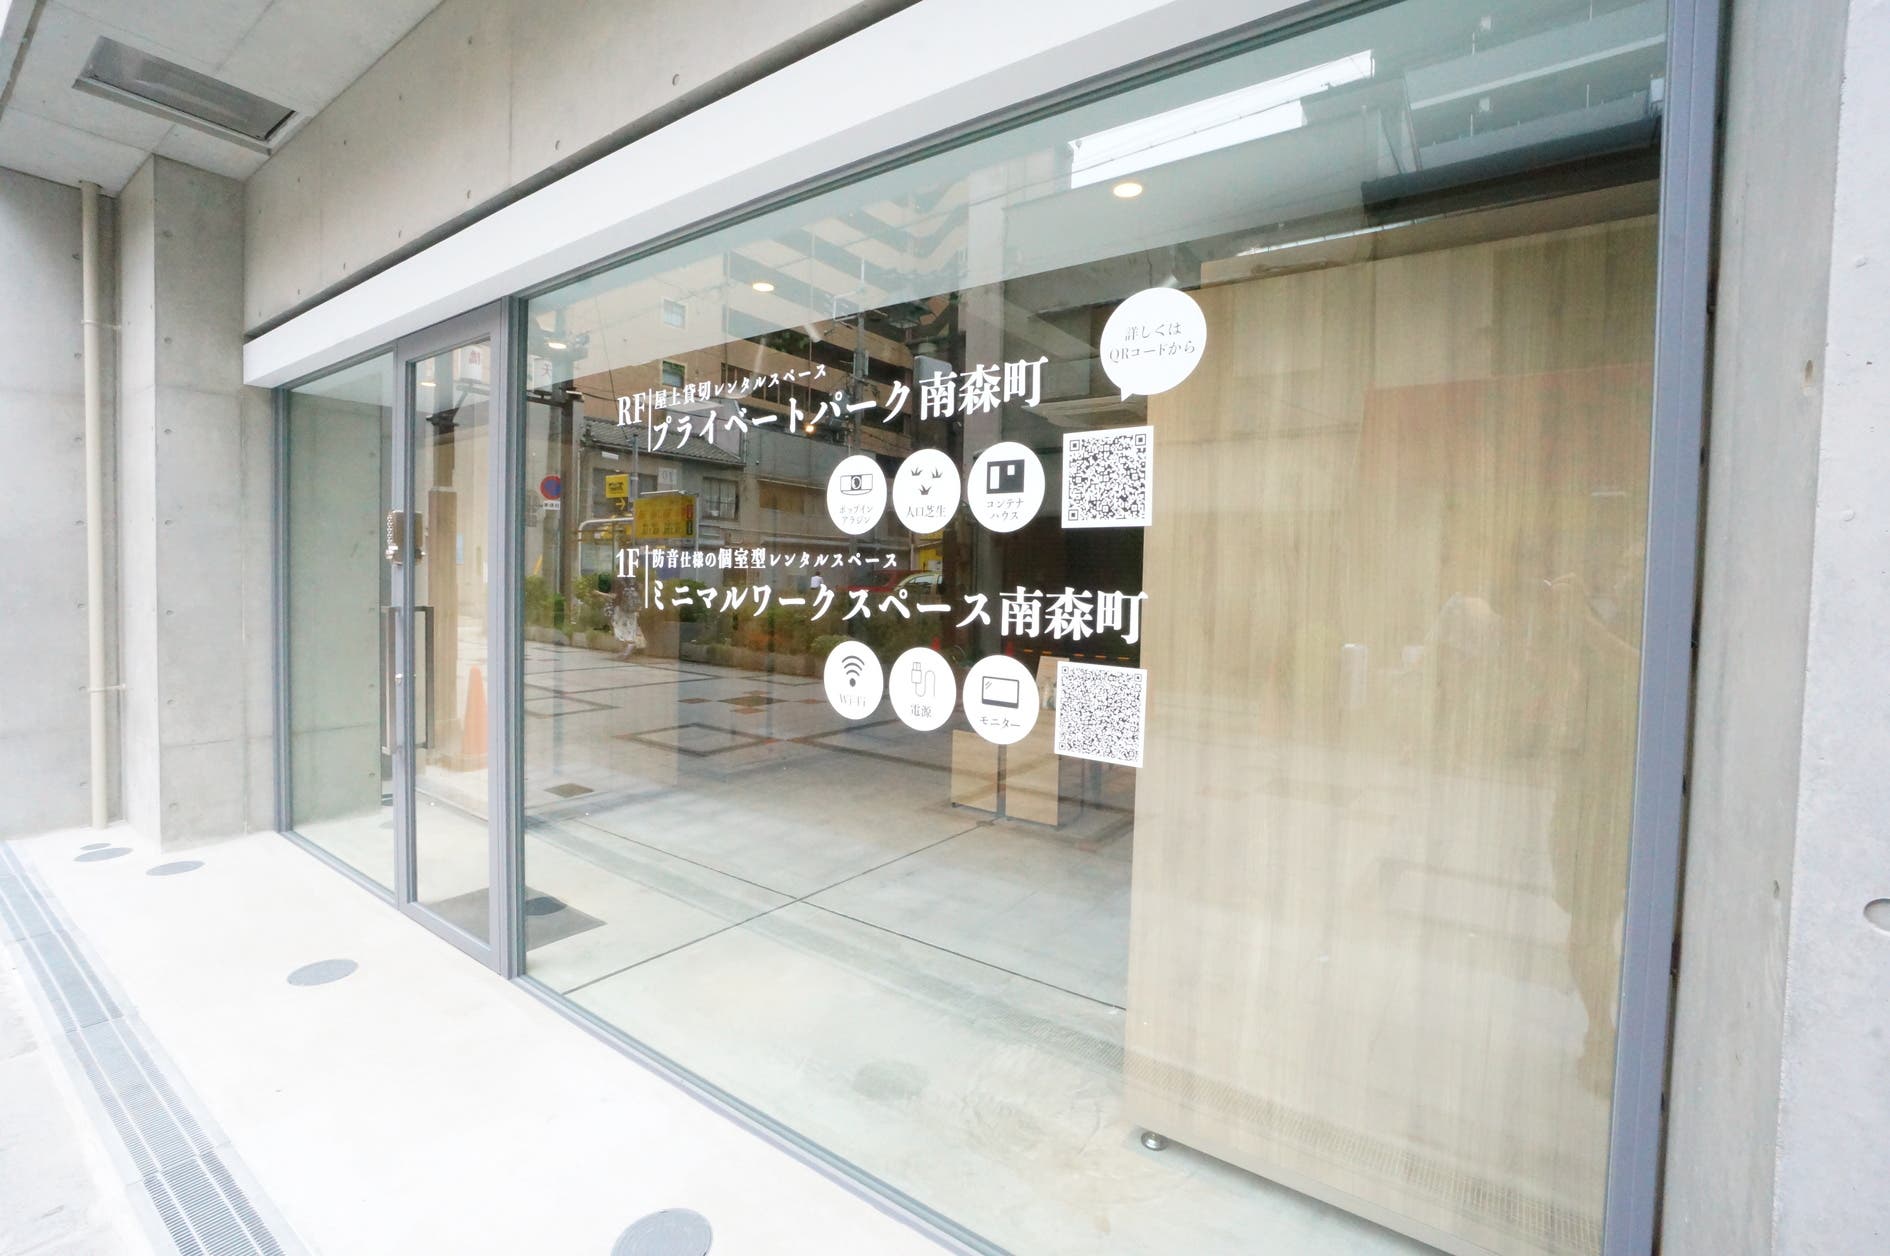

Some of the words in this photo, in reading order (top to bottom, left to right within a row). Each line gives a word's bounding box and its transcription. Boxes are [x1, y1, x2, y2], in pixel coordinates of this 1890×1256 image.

[1125, 322, 1182, 341] 詳しくは
[1109, 340, 1196, 363] QRコードから
[654, 364, 827, 410] 屋上貸切レンタルスペース
[617, 392, 646, 427] RF
[987, 498, 1024, 509] コンテナ
[990, 511, 1019, 521] ハウス
[615, 548, 640, 578] 1F
[652, 547, 897, 569] 防音仕様の個室型レンタルスペース
[654, 580, 1149, 645] ミニマルワークスペース南森町
[911, 703, 932, 718] 電源
[979, 716, 1021, 729] モニター
